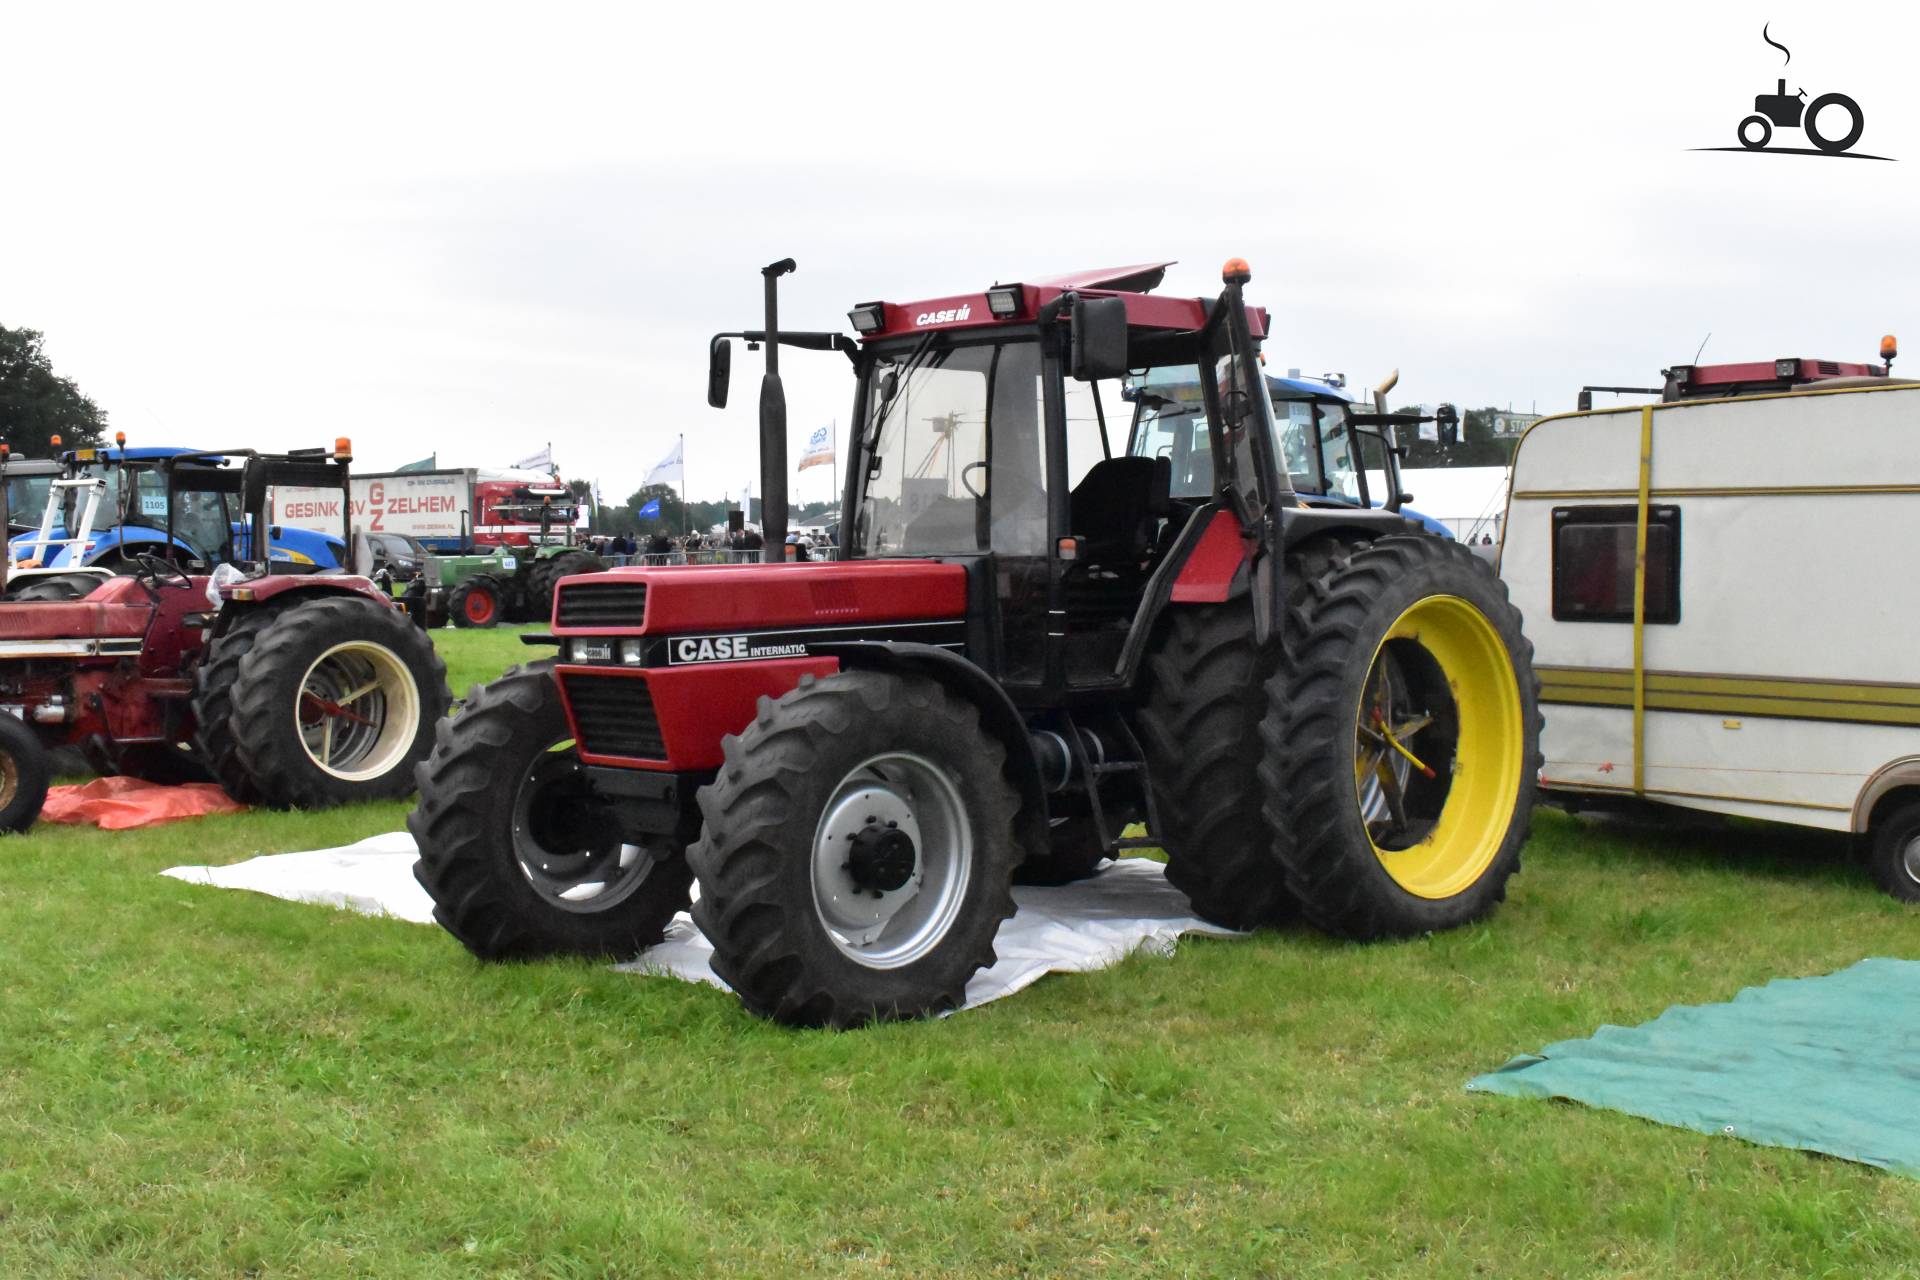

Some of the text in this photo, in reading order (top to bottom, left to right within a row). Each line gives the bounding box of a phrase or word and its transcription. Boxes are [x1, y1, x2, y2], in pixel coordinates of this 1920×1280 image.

[144, 501, 165, 509] 1105
[285, 501, 339, 518] GESINK
[387, 495, 456, 514] ZELHEM
[678, 637, 748, 661] CASE
